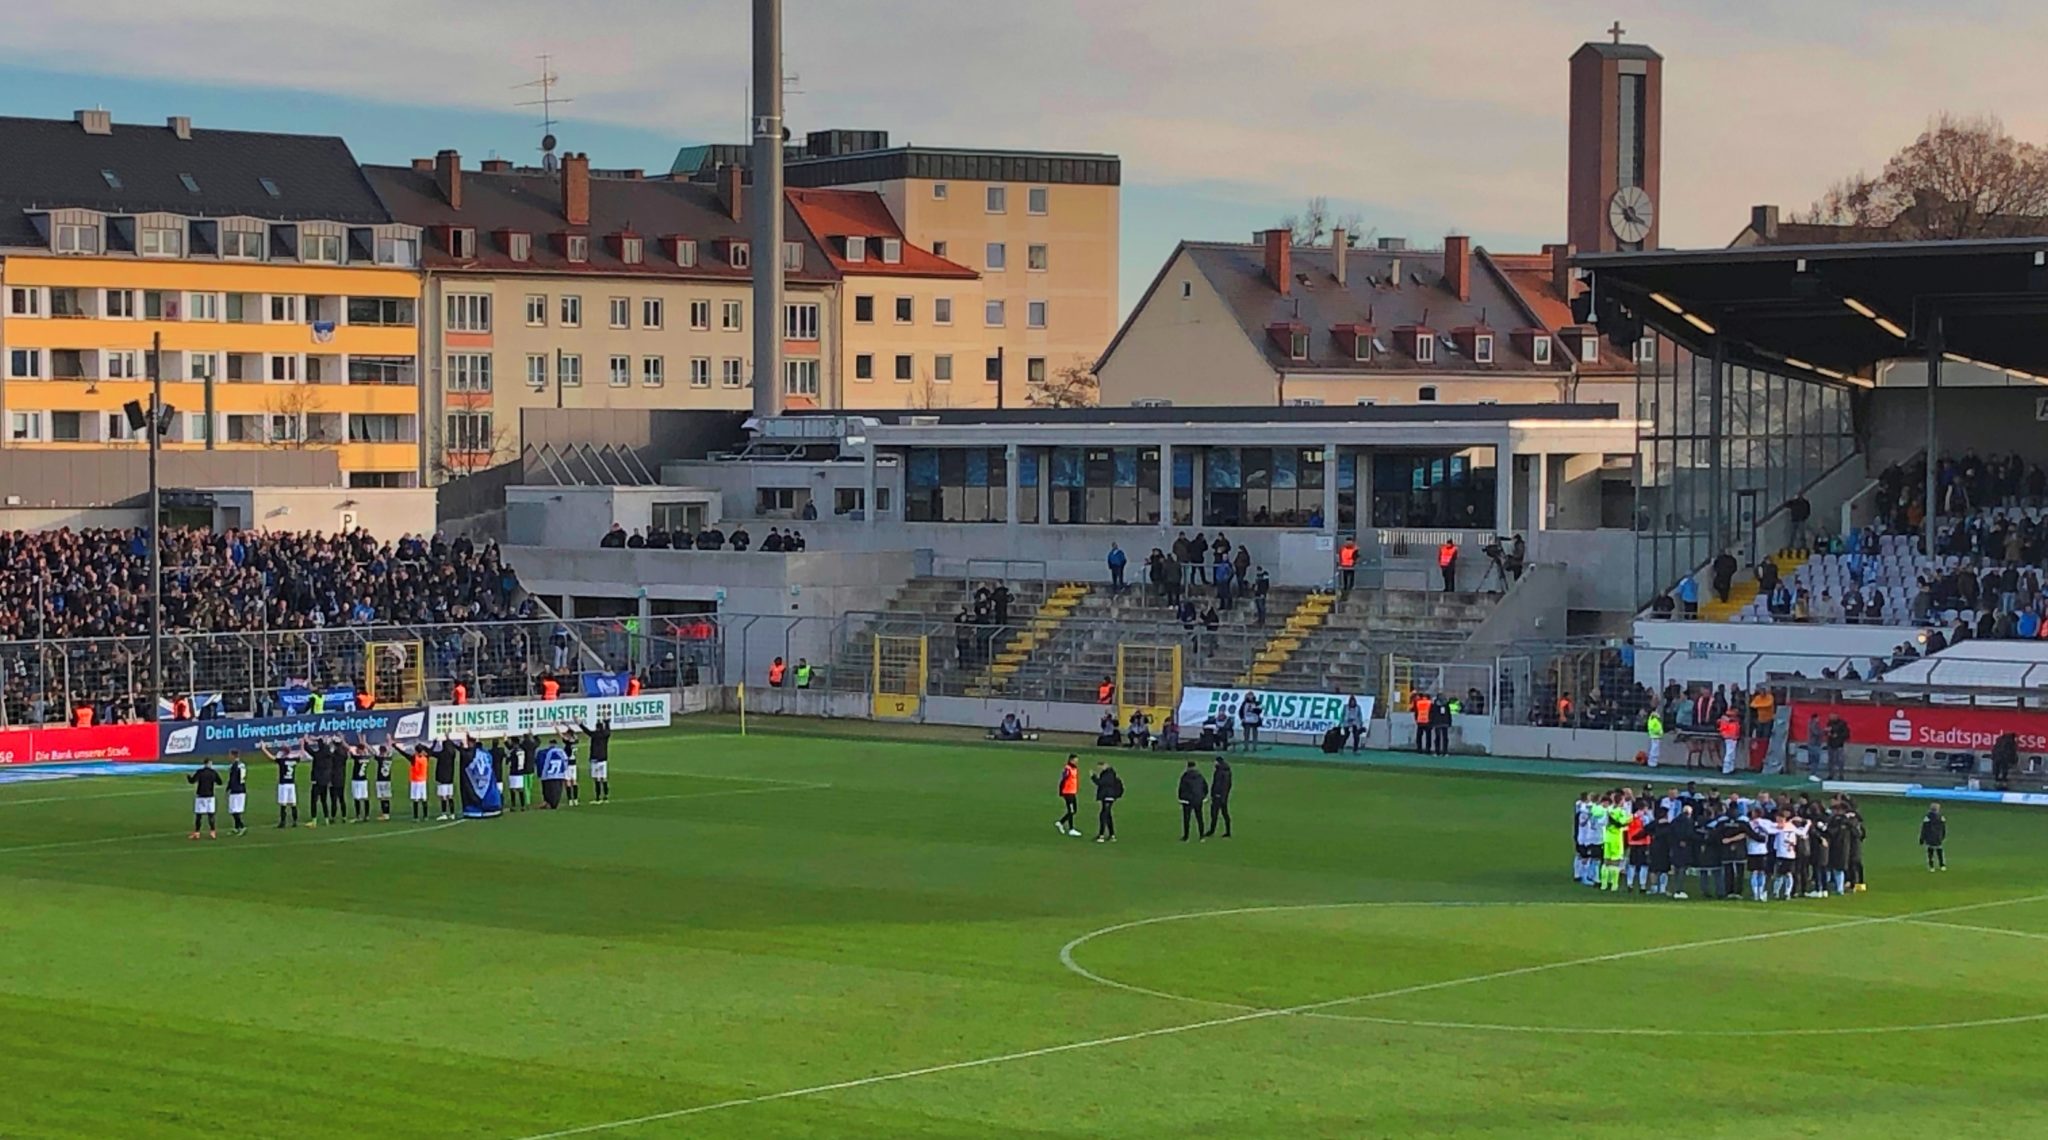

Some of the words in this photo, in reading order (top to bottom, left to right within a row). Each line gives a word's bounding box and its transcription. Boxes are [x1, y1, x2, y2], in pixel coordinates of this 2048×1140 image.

[344, 514, 353, 530] P
[537, 705, 588, 721] LINSTER
[614, 700, 664, 717] LINSTER
[455, 709, 509, 725] LINSTER
[205, 725, 234, 740] Dein
[238, 720, 316, 738] löwenstarker
[319, 715, 388, 733] Arbeitgeber
[1919, 726, 2046, 748] Stadtsparsse
[35, 751, 50, 762] Die
[51, 749, 73, 761] Bank
